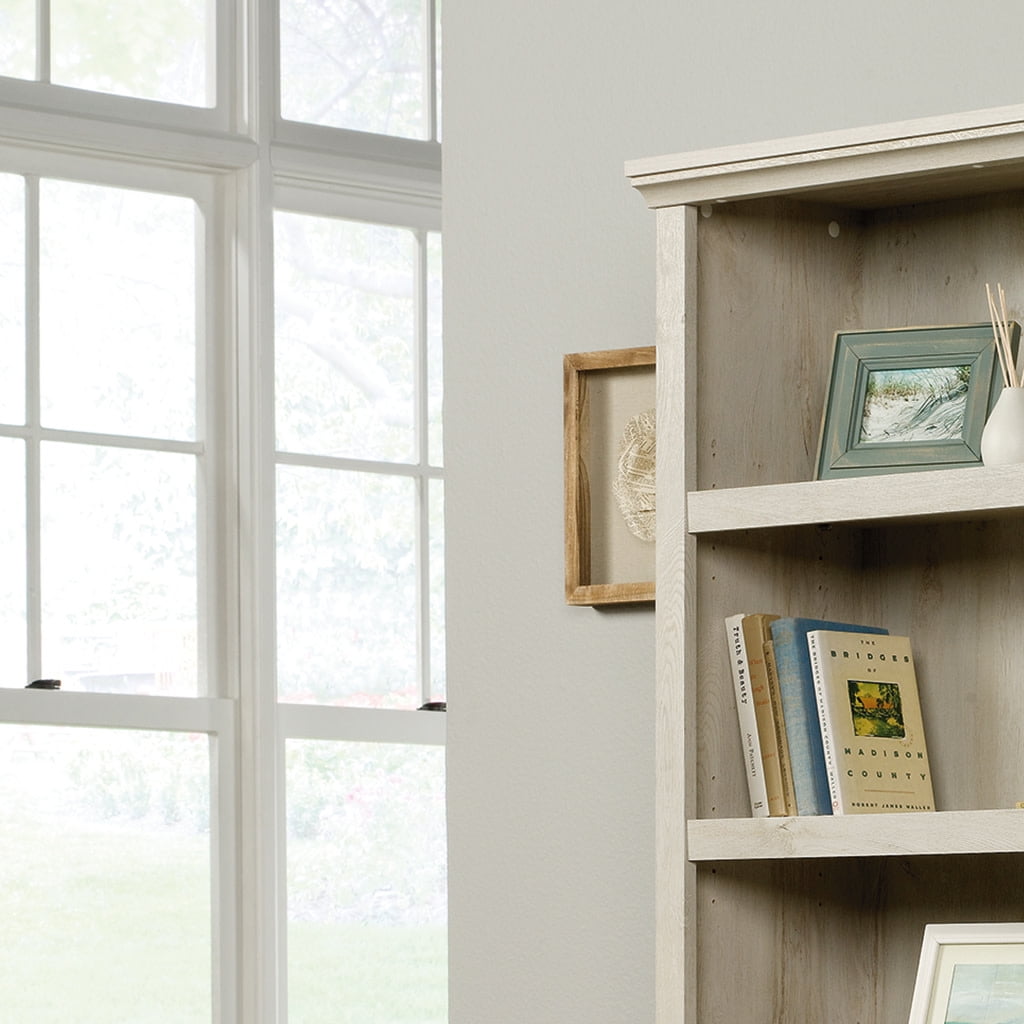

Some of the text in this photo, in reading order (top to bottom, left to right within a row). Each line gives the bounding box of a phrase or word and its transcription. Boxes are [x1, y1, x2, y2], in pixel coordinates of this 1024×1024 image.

[831, 650, 909, 663] BRIDGES
[733, 626, 742, 656] Truth
[738, 668, 748, 704] Beauty
[844, 748, 923, 759] MADISON
[847, 770, 926, 780] COUNTY
